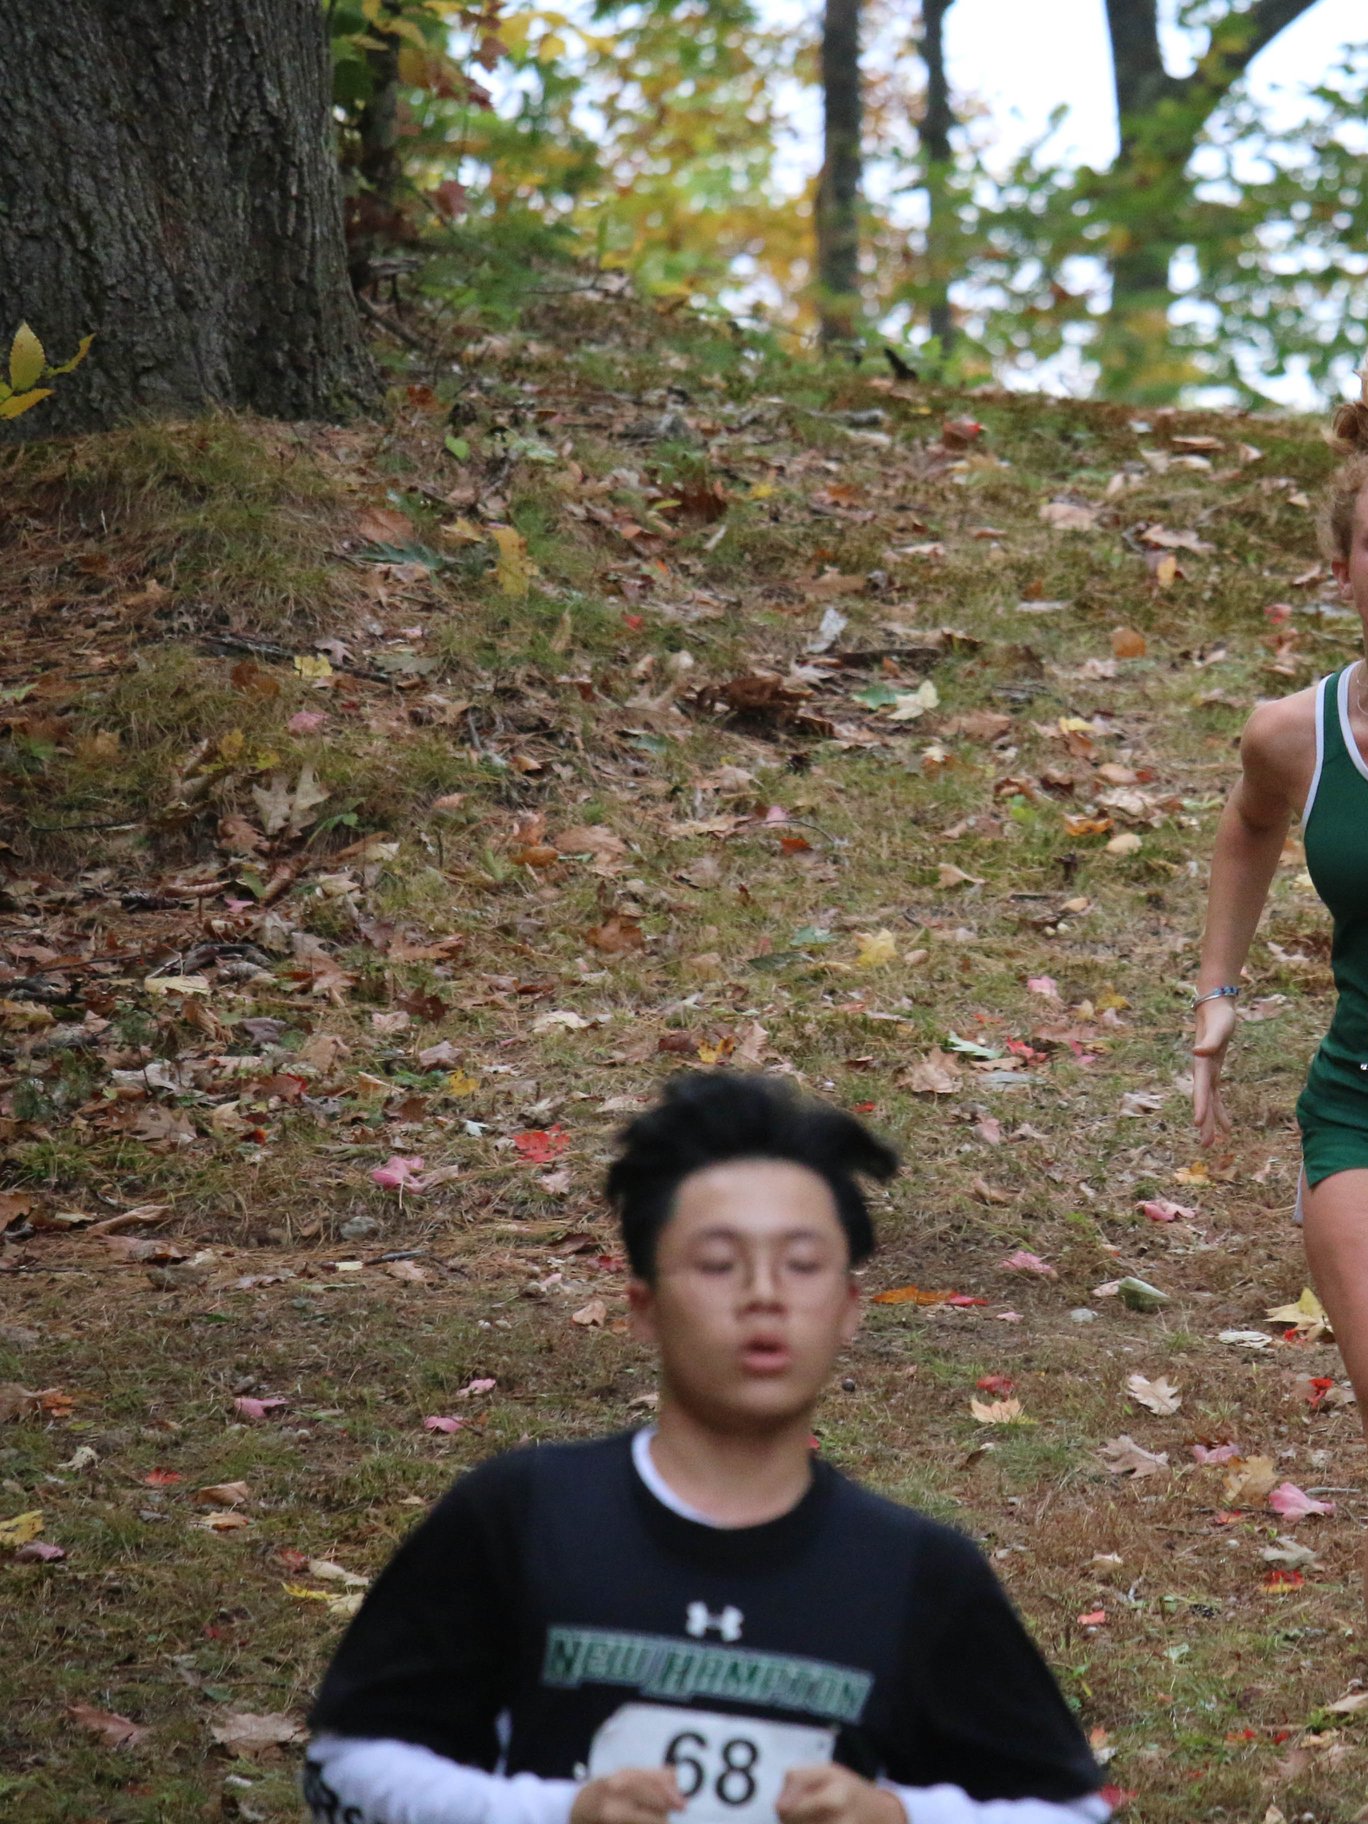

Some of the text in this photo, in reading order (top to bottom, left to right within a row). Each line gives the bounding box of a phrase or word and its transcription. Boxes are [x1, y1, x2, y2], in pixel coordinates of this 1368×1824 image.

[544, 1625, 873, 1722] NEW HAMPTON
[664, 1731, 758, 1806] 68
